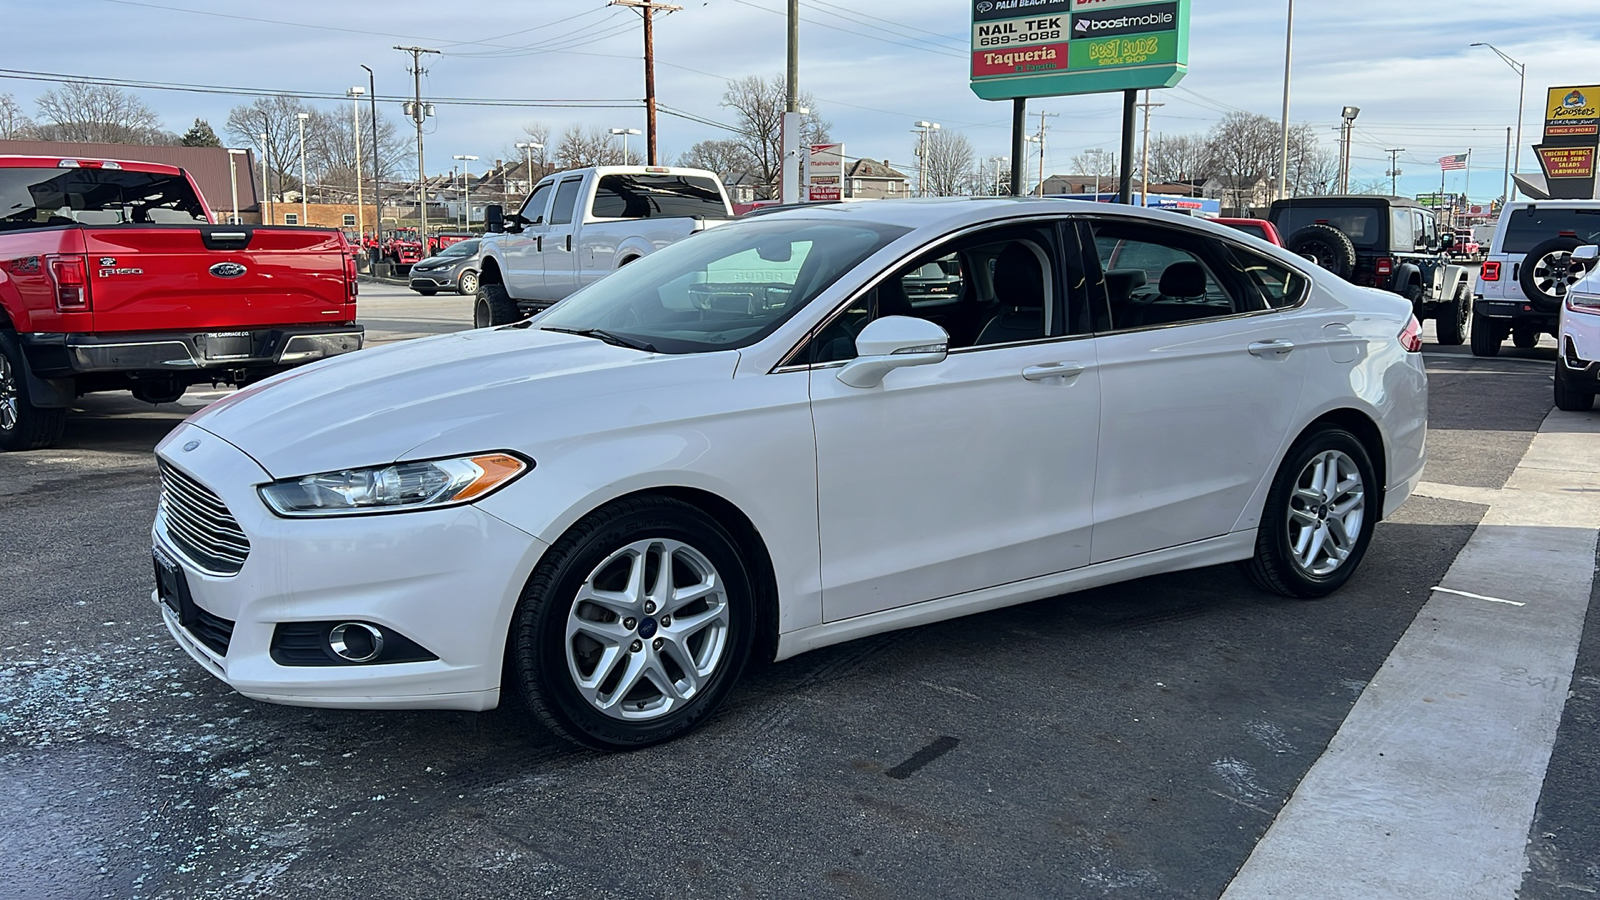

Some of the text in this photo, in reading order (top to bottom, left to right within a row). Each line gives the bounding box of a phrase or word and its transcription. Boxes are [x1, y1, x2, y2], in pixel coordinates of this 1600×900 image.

[995, 0, 1018, 10] PALM
[979, 17, 1062, 36] NAIL TEK
[980, 30, 1060, 46] 689-9088
[1098, 55, 1147, 66] SMOKE SHOP
[1552, 105, 1596, 118] Roosters
